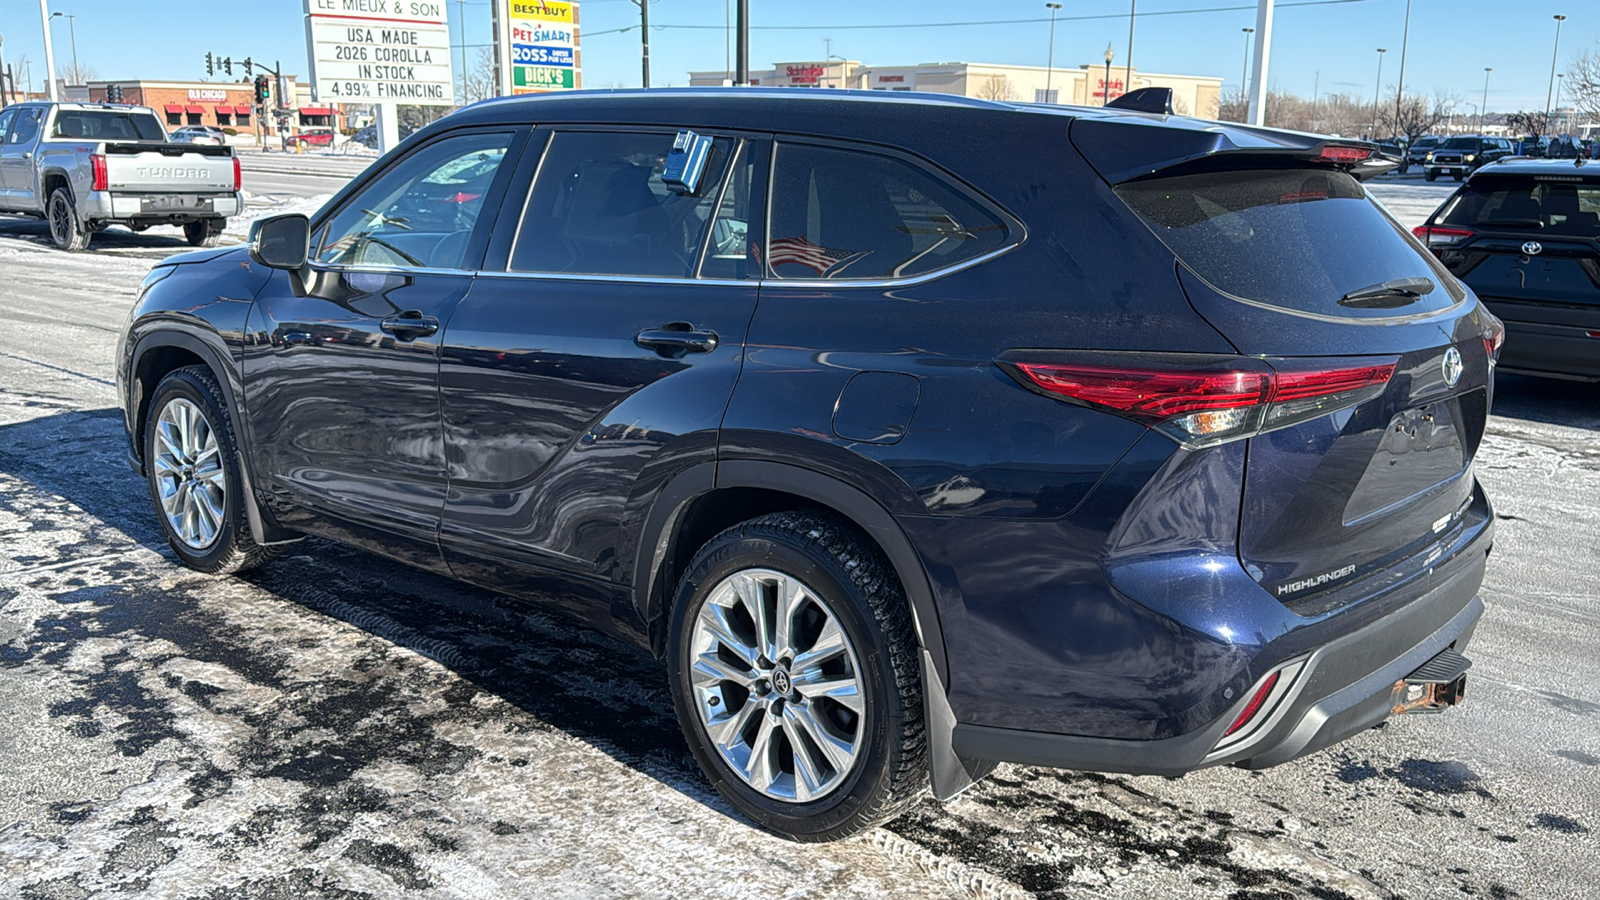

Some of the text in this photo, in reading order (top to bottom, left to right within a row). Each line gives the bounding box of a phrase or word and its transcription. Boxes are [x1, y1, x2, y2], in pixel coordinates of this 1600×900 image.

[318, 0, 440, 17] LE MIEUX & SON
[514, 4, 568, 17] BEST BUY
[347, 27, 418, 45] USA MADE
[335, 45, 432, 63] 2026 COROLLA
[513, 47, 548, 62] ROSS
[358, 64, 415, 80] IN STOCK
[524, 67, 564, 84] DICK'S
[331, 82, 443, 98] 4.99% FINANCING
[137, 167, 211, 179] TUNDRA
[1277, 563, 1356, 596] HIGHLANDER
